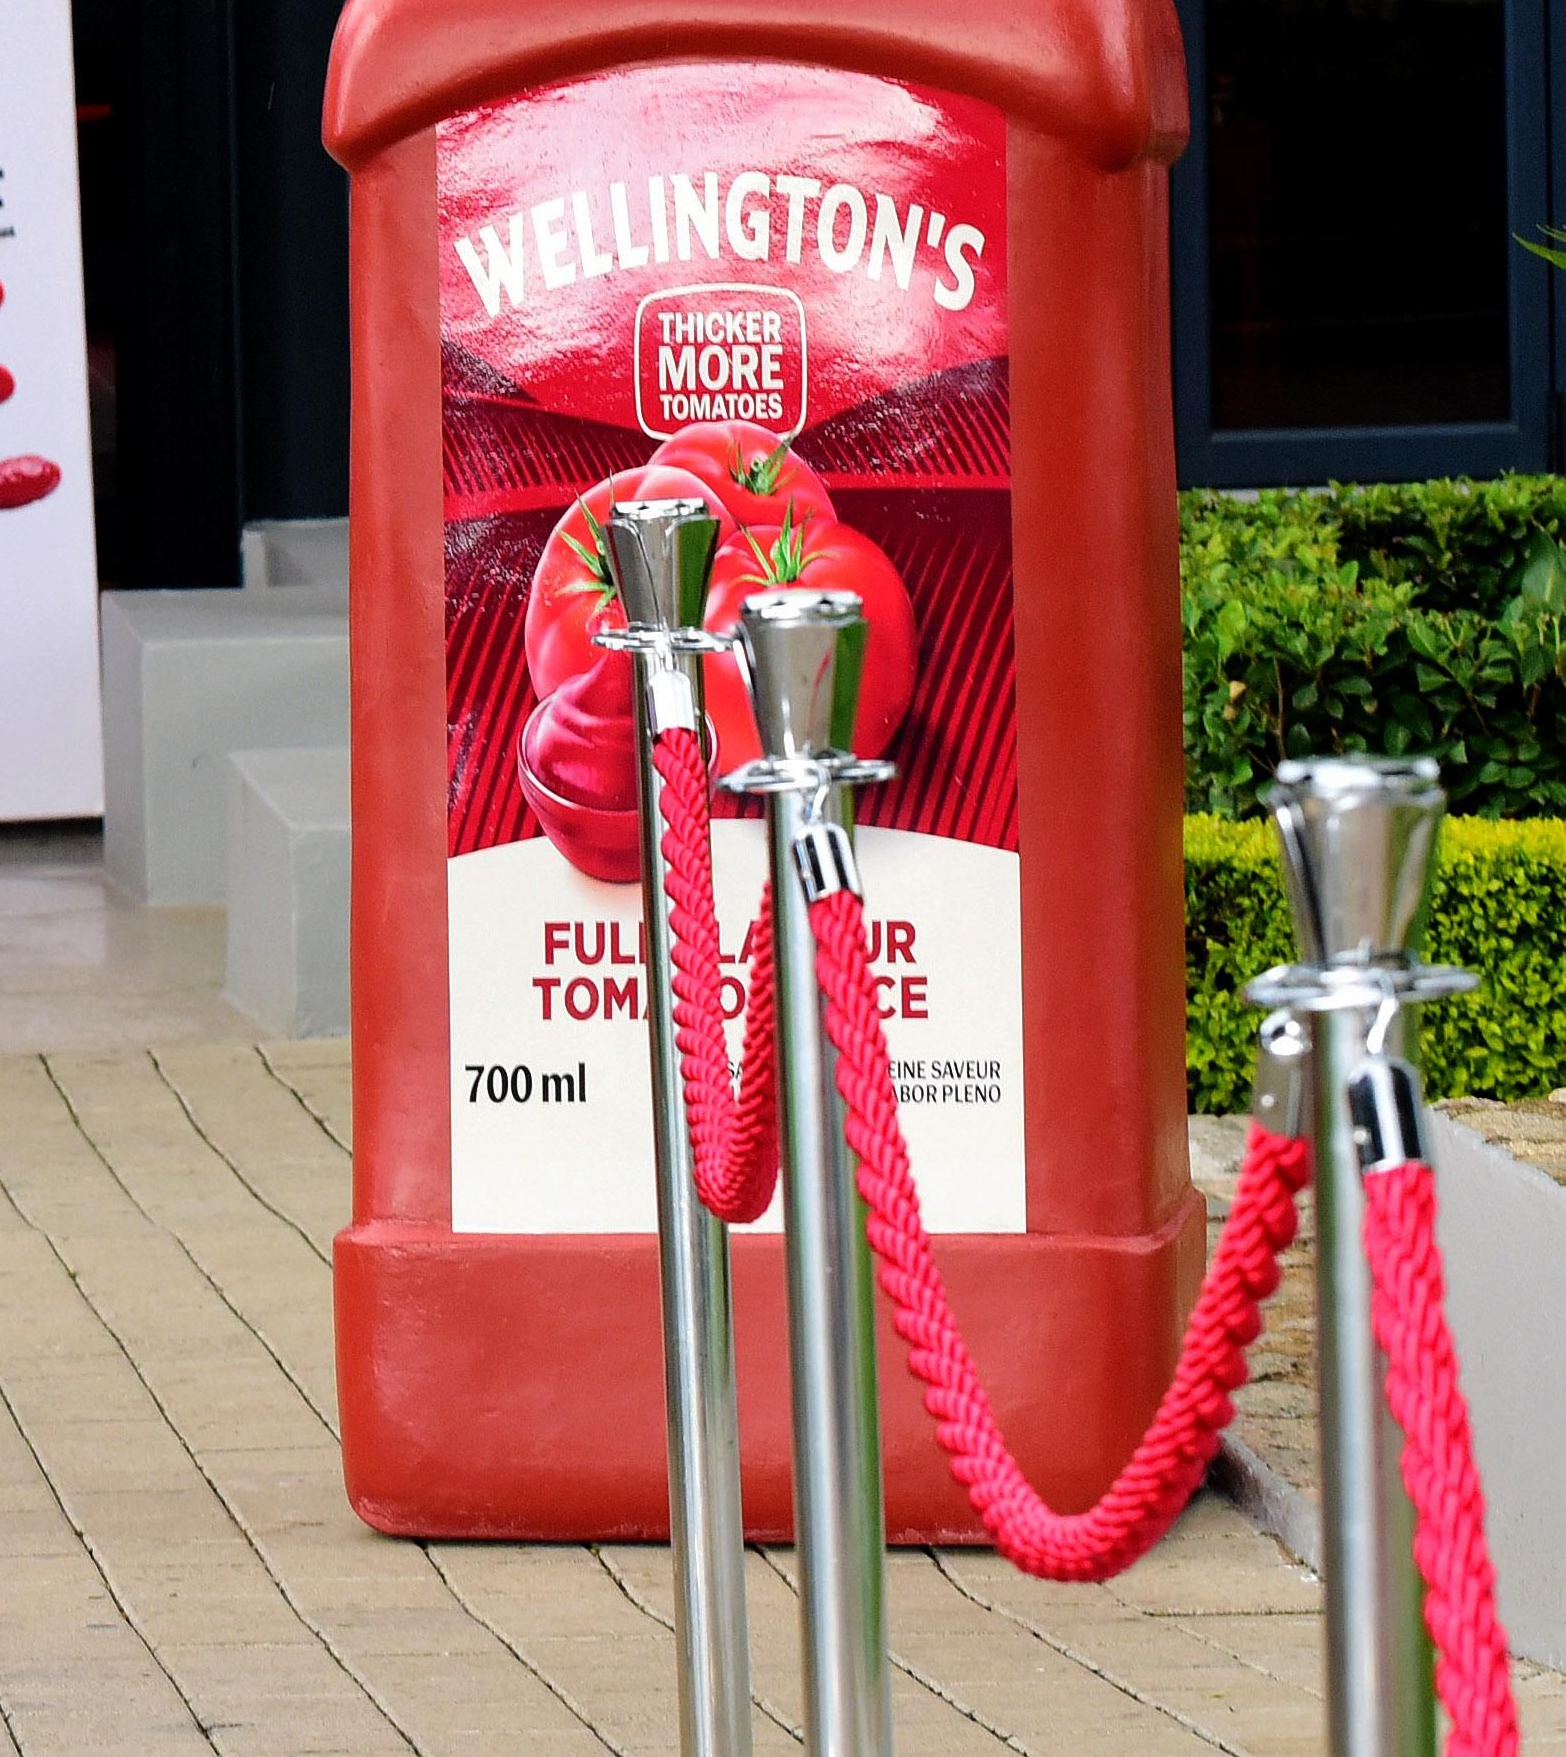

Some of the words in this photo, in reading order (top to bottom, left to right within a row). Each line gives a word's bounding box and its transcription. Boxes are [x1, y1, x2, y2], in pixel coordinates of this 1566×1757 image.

[454, 170, 986, 318] WELLINGTON'S
[658, 309, 782, 344] THICKER
[658, 345, 785, 392] MORE
[659, 393, 783, 421] TOMATOES
[532, 976, 745, 1021] TOMO
[465, 1064, 533, 1103] 700
[542, 1062, 587, 1103] ml
[930, 1060, 1001, 1080] SAVEUR
[942, 1084, 1002, 1103] PLENO
